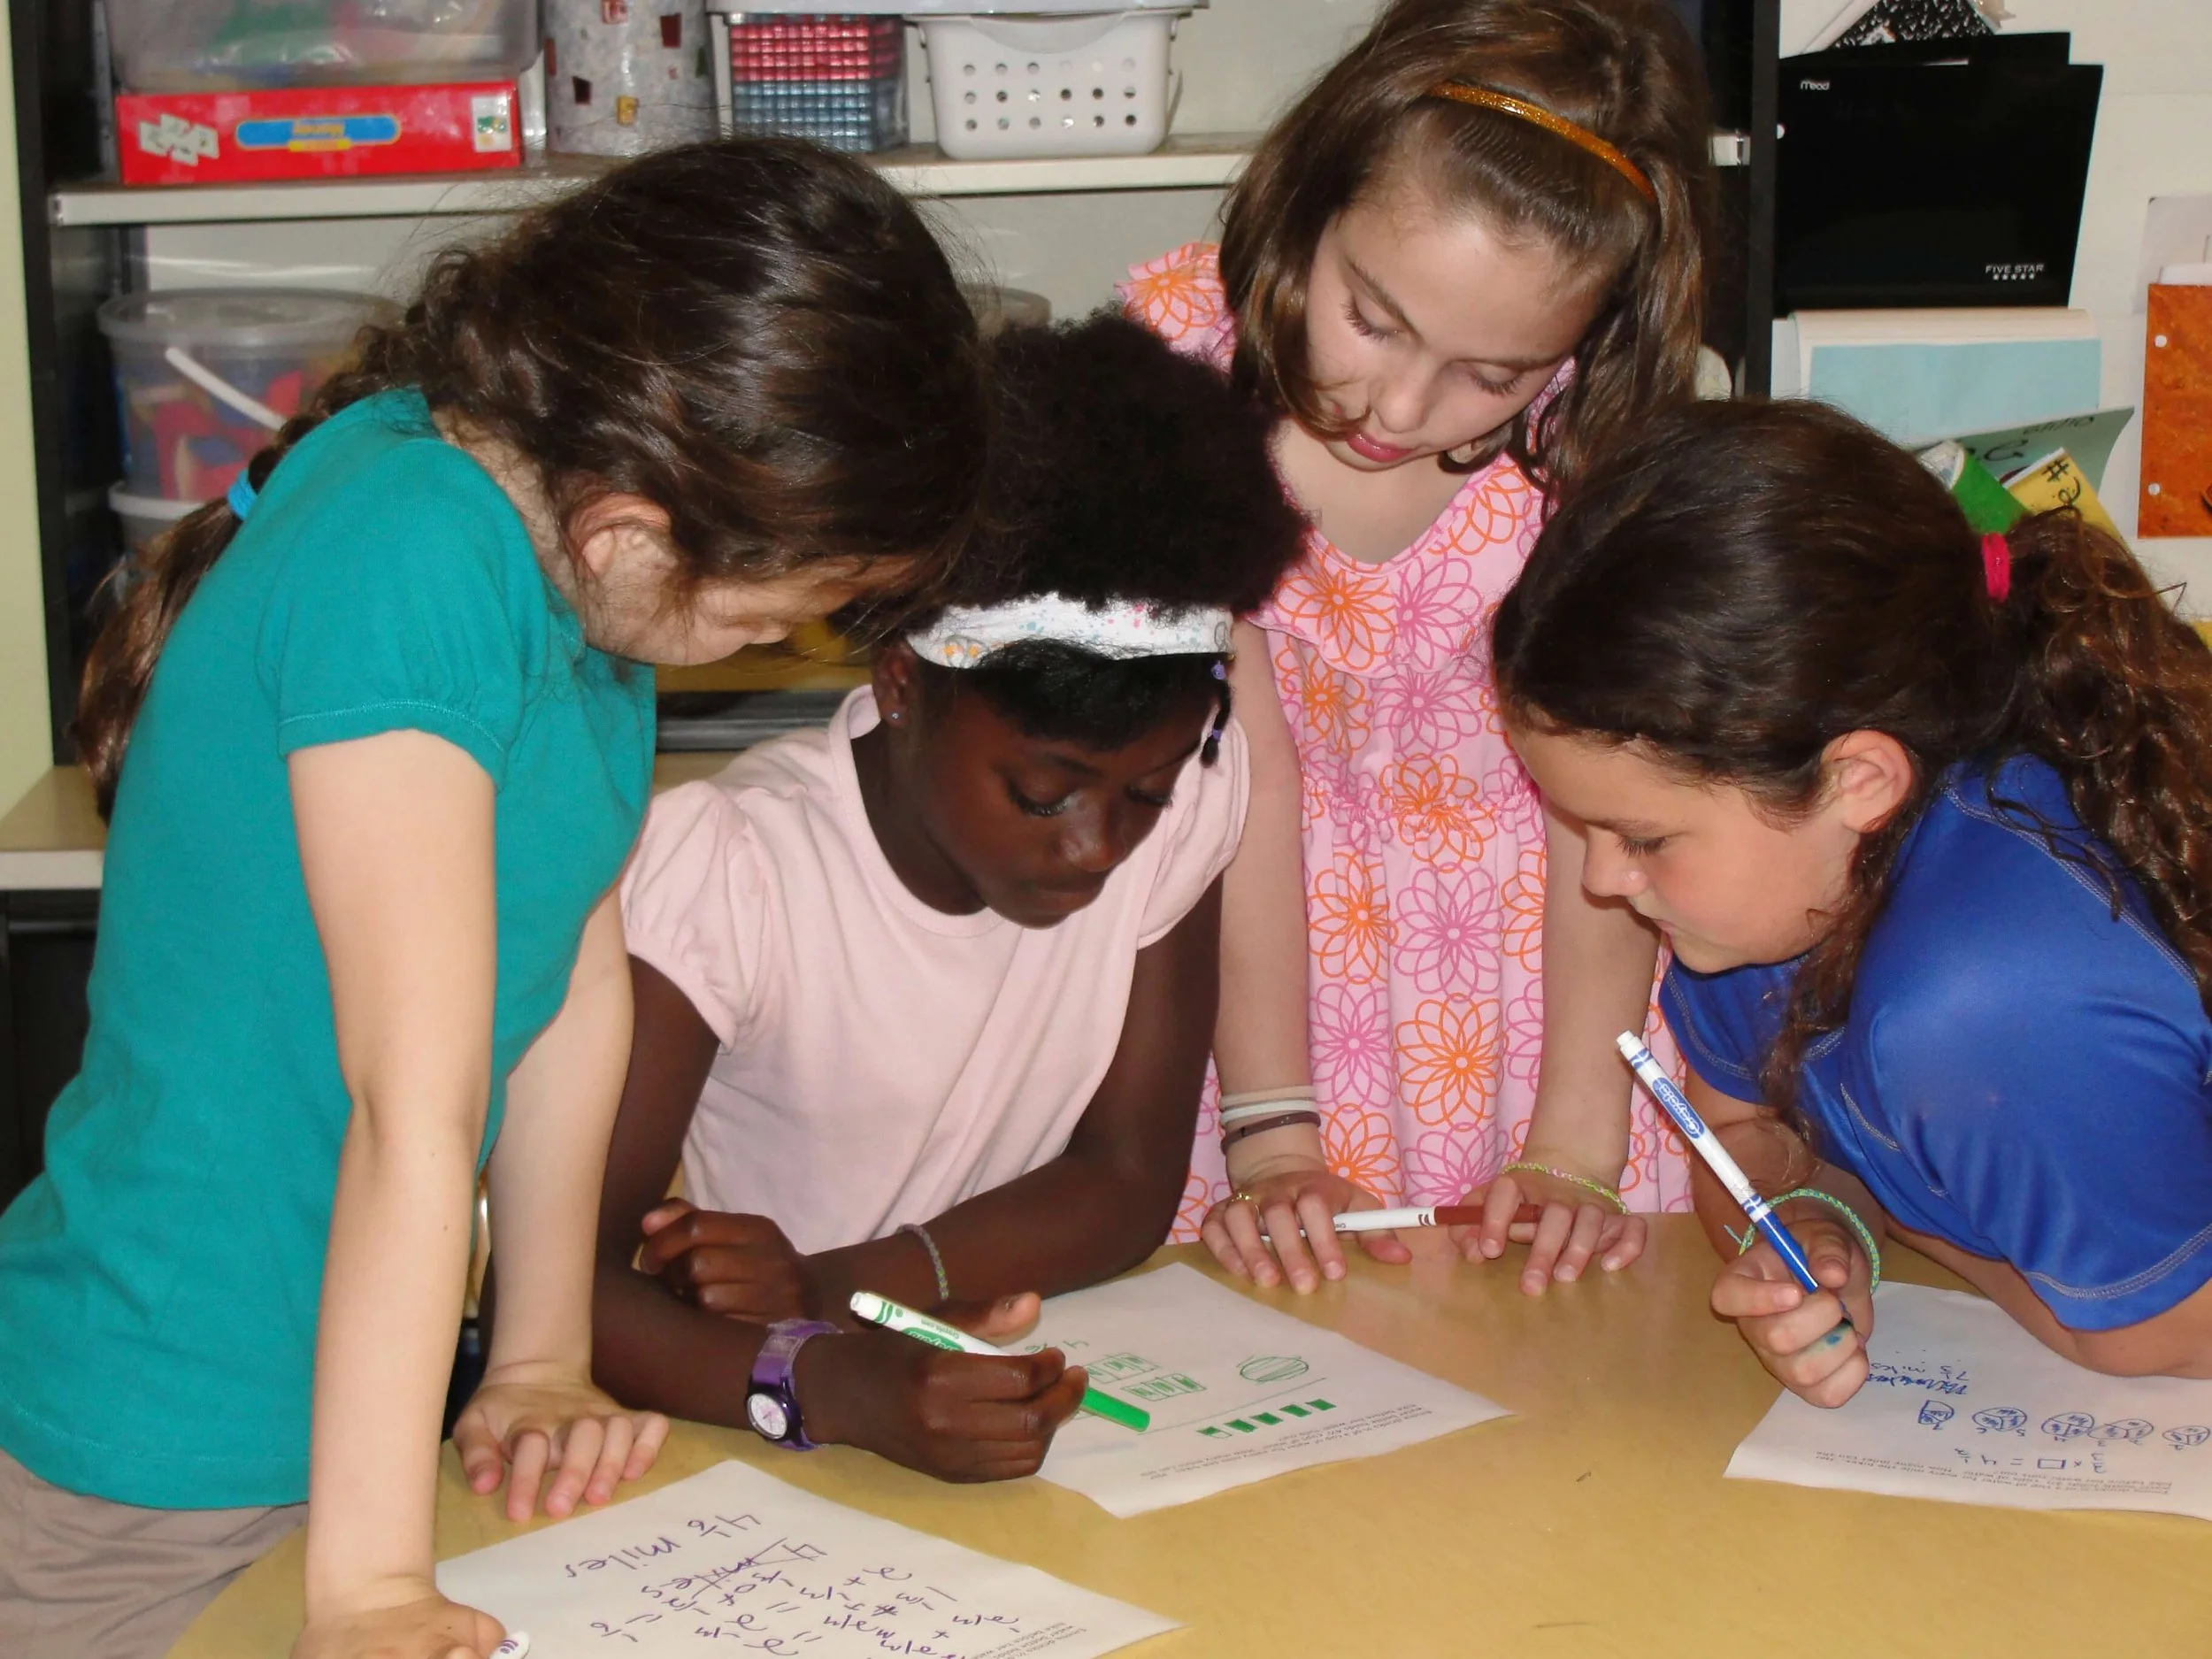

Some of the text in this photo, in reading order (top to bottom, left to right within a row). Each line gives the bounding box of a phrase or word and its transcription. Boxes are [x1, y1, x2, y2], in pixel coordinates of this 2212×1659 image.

[1985, 264, 2045, 273] FIVE STAR
[1659, 1083, 1699, 1133] Crayola
[715, 1515, 761, 1530] 4
[565, 1537, 681, 1578] miles
